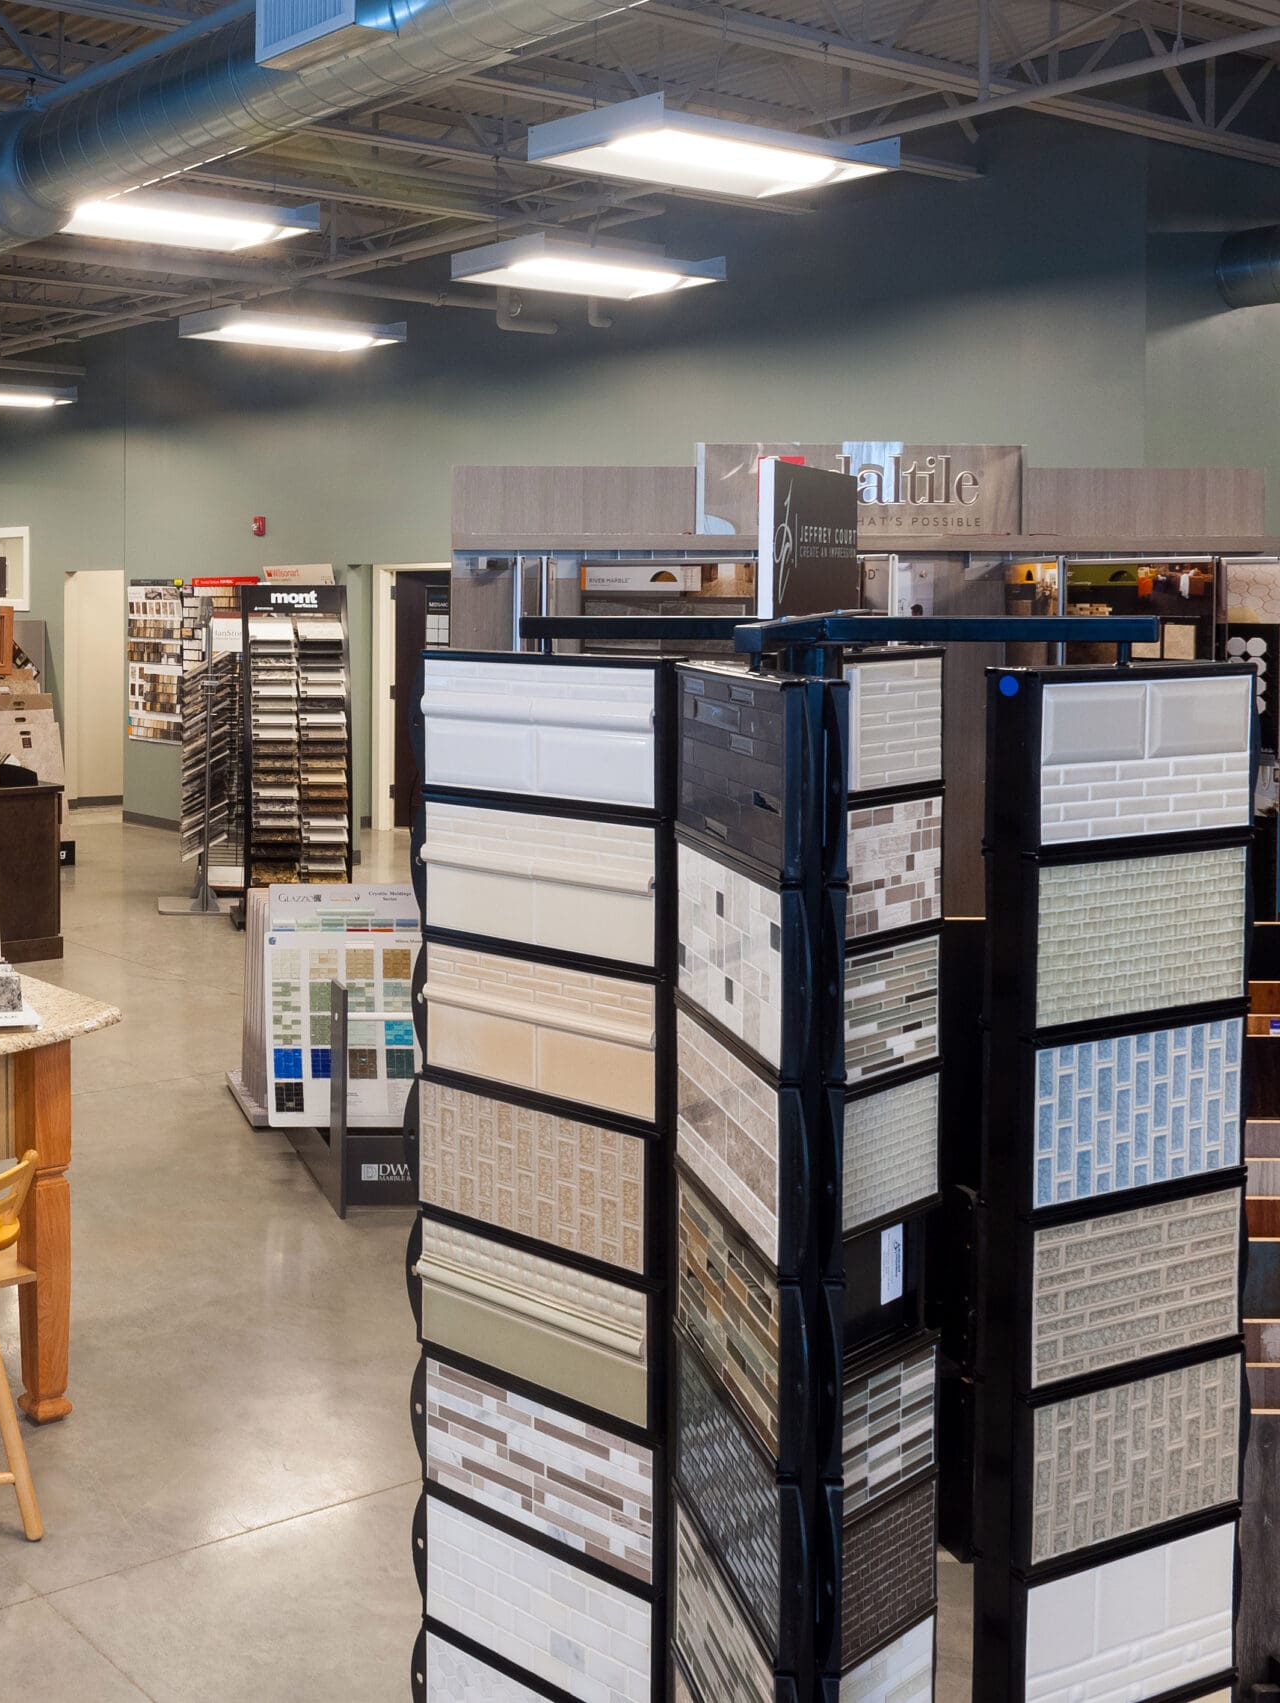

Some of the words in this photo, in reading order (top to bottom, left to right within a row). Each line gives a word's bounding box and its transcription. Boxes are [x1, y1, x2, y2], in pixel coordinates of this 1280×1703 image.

[911, 516, 982, 528] POSSIBLE
[799, 525, 832, 544] JEFFREY
[834, 527, 857, 545] COURT
[270, 590, 318, 604] mont
